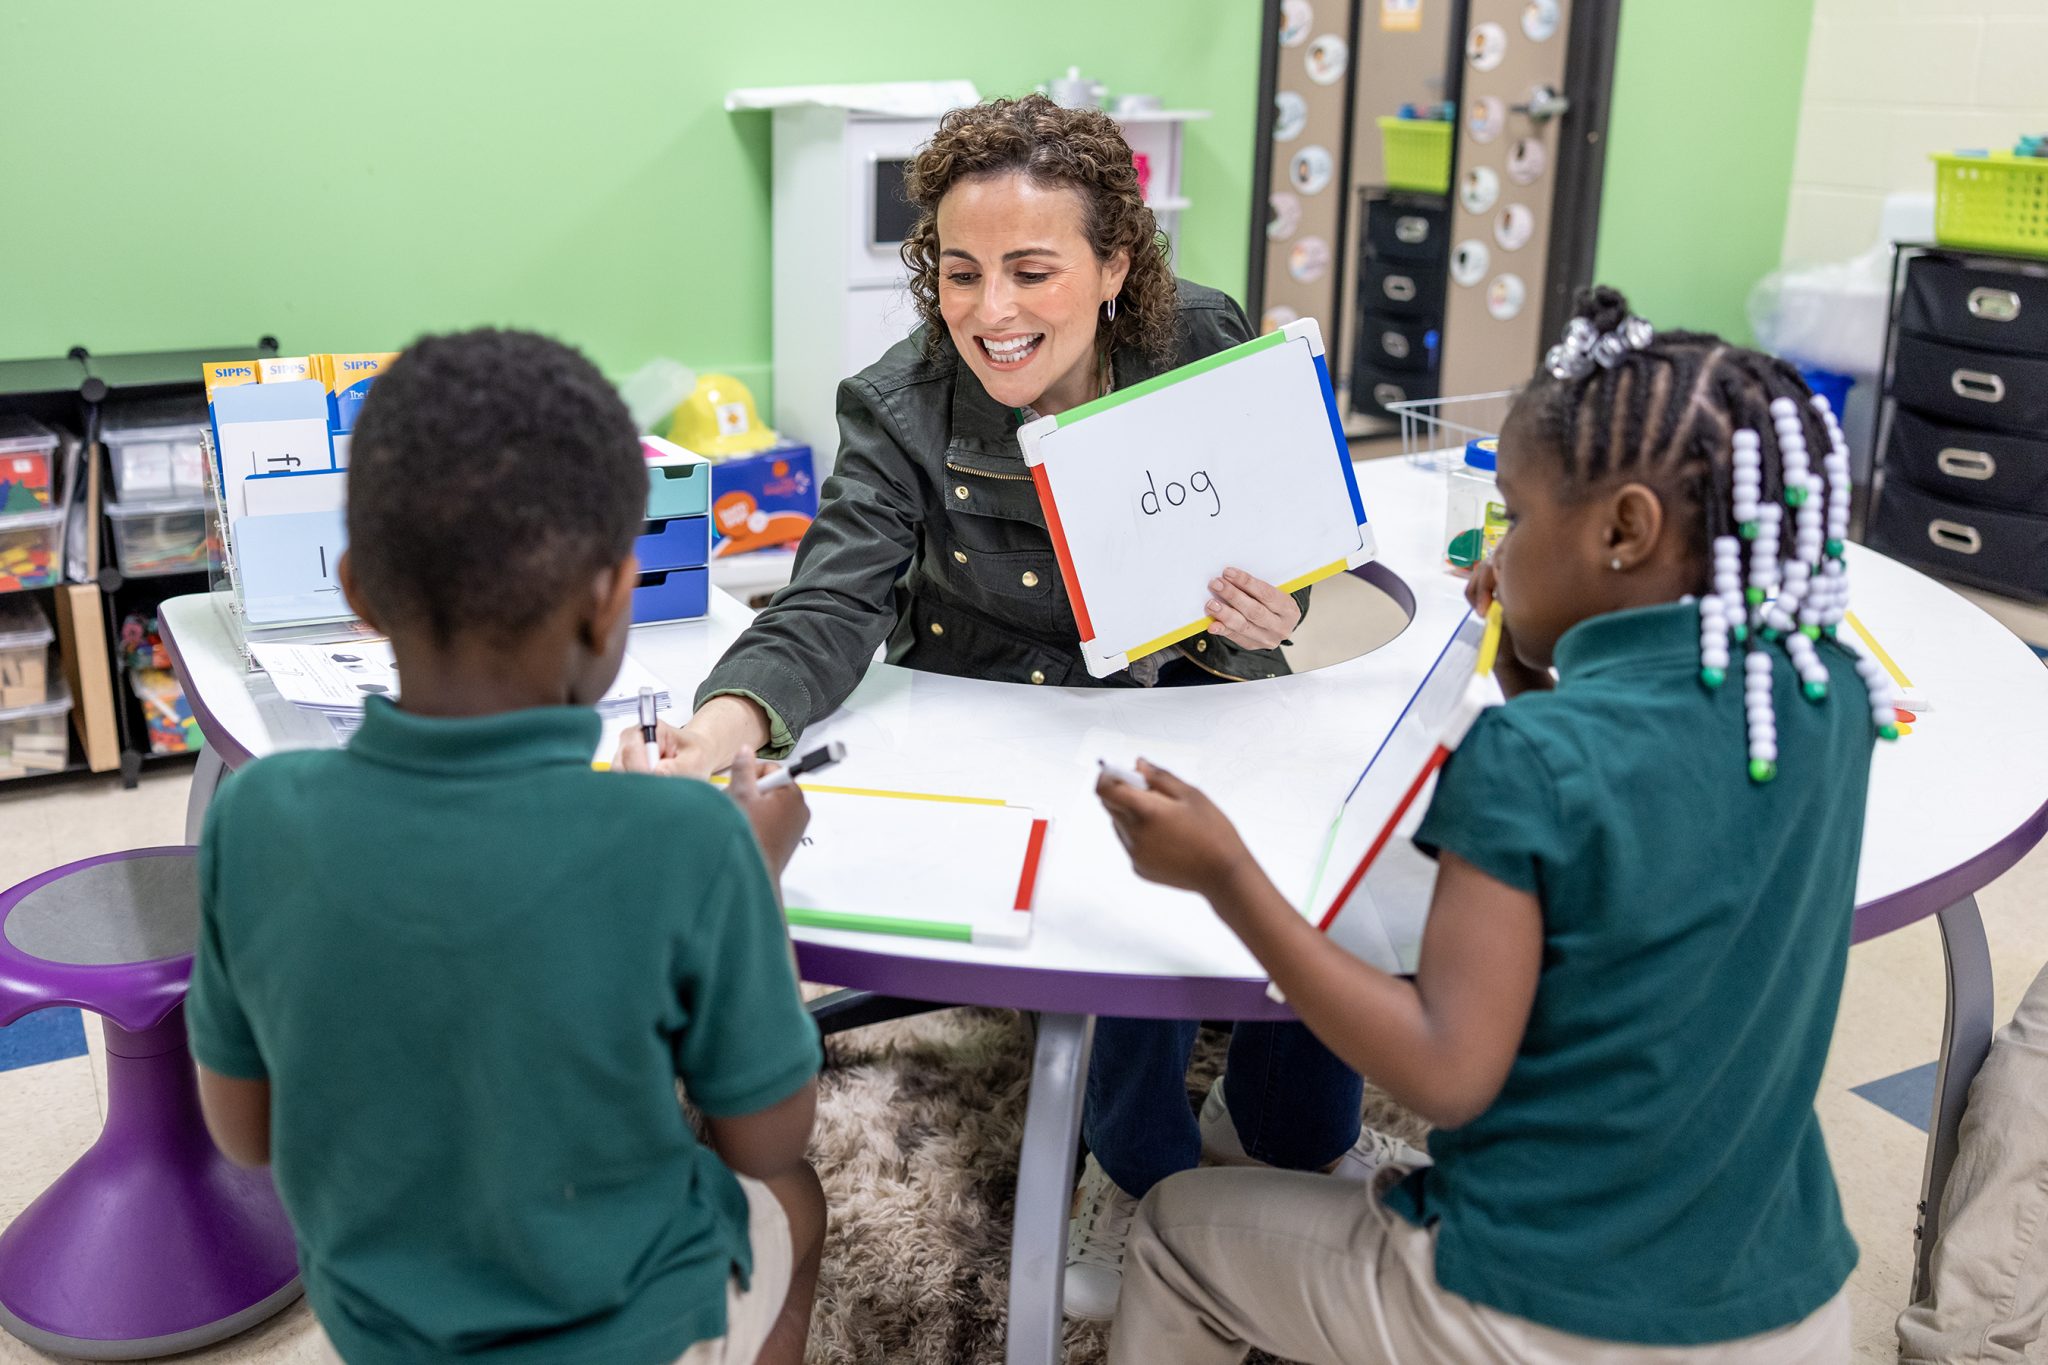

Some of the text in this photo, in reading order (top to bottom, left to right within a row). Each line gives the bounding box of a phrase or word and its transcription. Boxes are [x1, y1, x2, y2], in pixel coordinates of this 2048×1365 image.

[270, 364, 305, 374] SIPPS
[344, 360, 378, 370] SIPPS
[215, 367, 251, 378] SIPPS
[1141, 470, 1221, 517] dog
